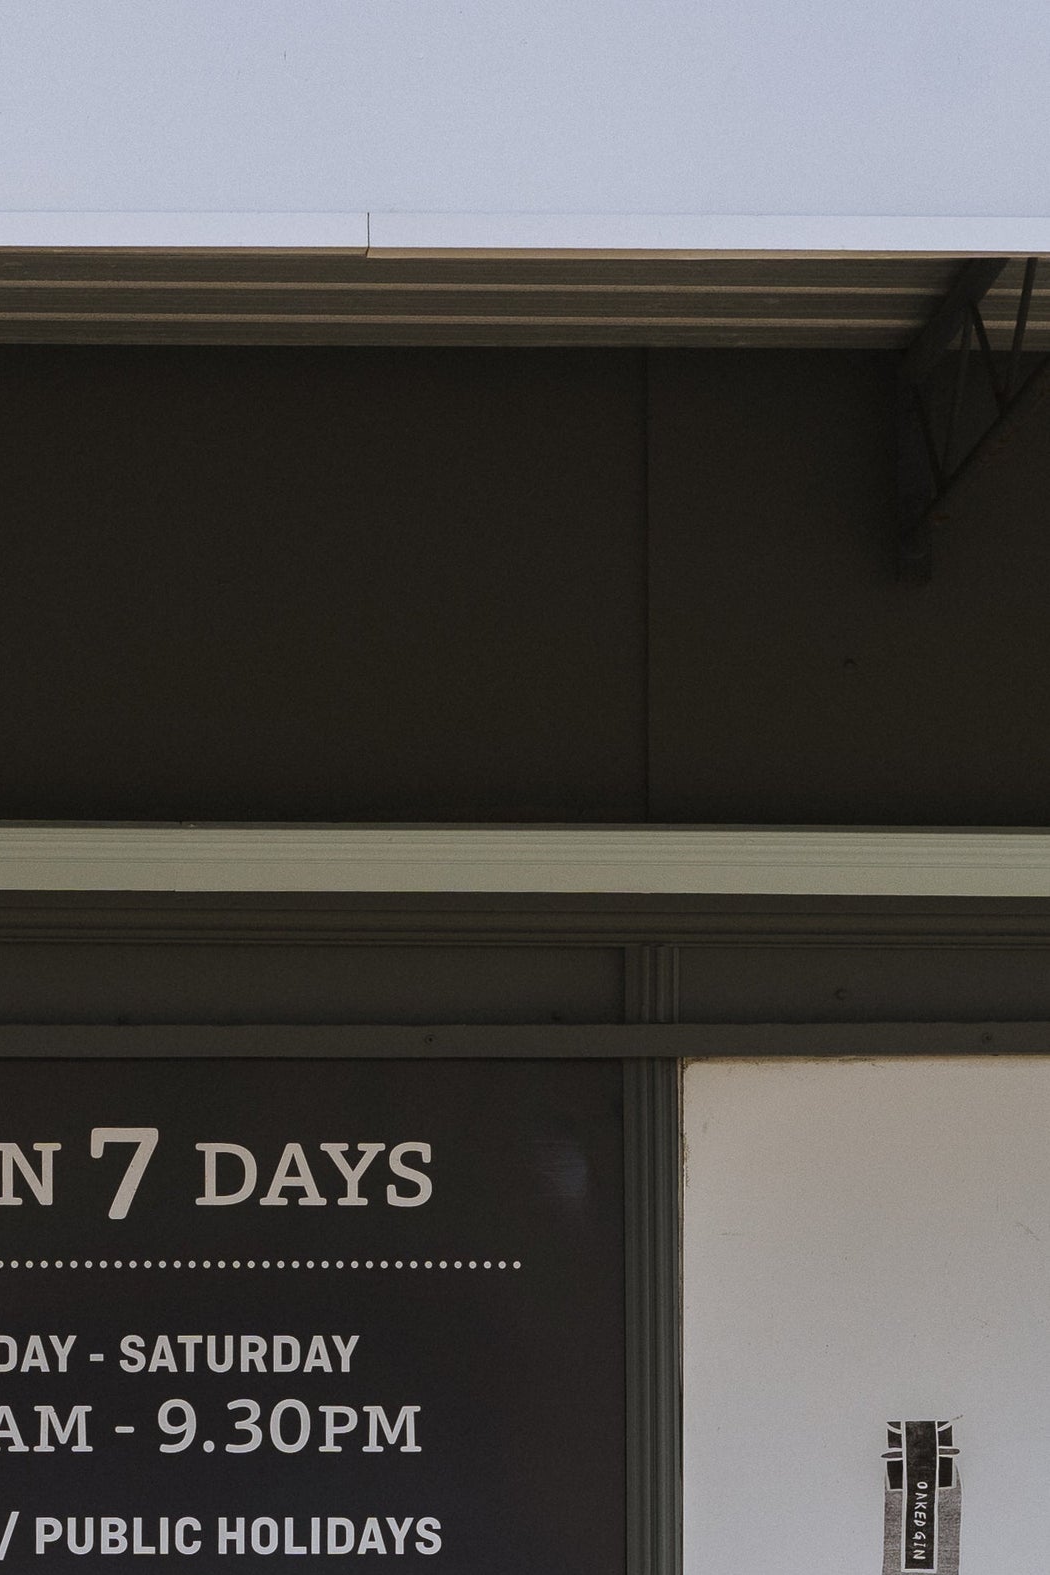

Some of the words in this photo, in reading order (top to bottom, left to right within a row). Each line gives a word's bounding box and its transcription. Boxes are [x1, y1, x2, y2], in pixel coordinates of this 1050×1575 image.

[91, 1128, 158, 1219] 7
[196, 1142, 432, 1207] DAYS
[120, 1335, 359, 1373] SATURDAY
[158, 1399, 422, 1453] 9.30PM
[913, 1481, 928, 1527] OAKED
[36, 1517, 201, 1555] PUBLIC
[218, 1517, 441, 1555] HOLIDAYS
[912, 1531, 926, 1560] GIN
